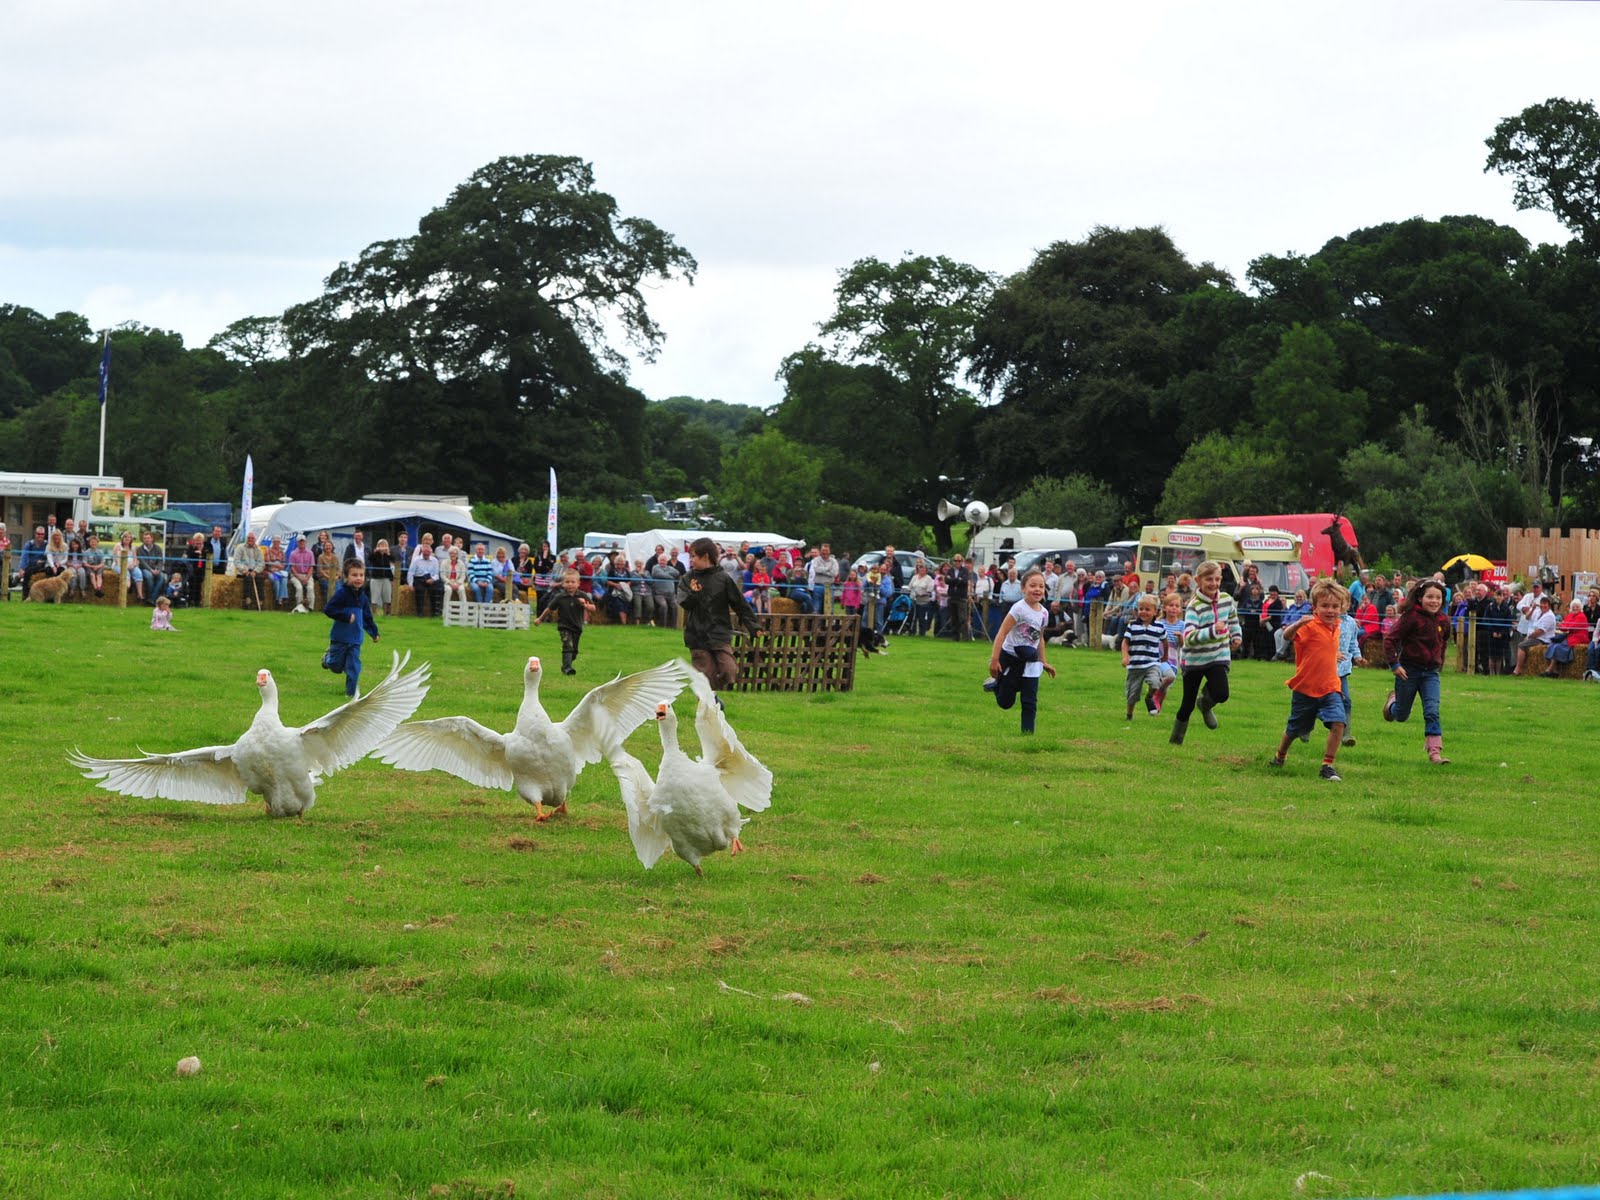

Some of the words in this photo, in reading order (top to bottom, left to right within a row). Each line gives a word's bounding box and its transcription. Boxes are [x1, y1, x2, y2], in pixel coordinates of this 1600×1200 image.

[1183, 535, 1200, 543] RAINBOW
[1243, 540, 1263, 548] KELLY'S
[1264, 540, 1290, 548] RAINBOW
